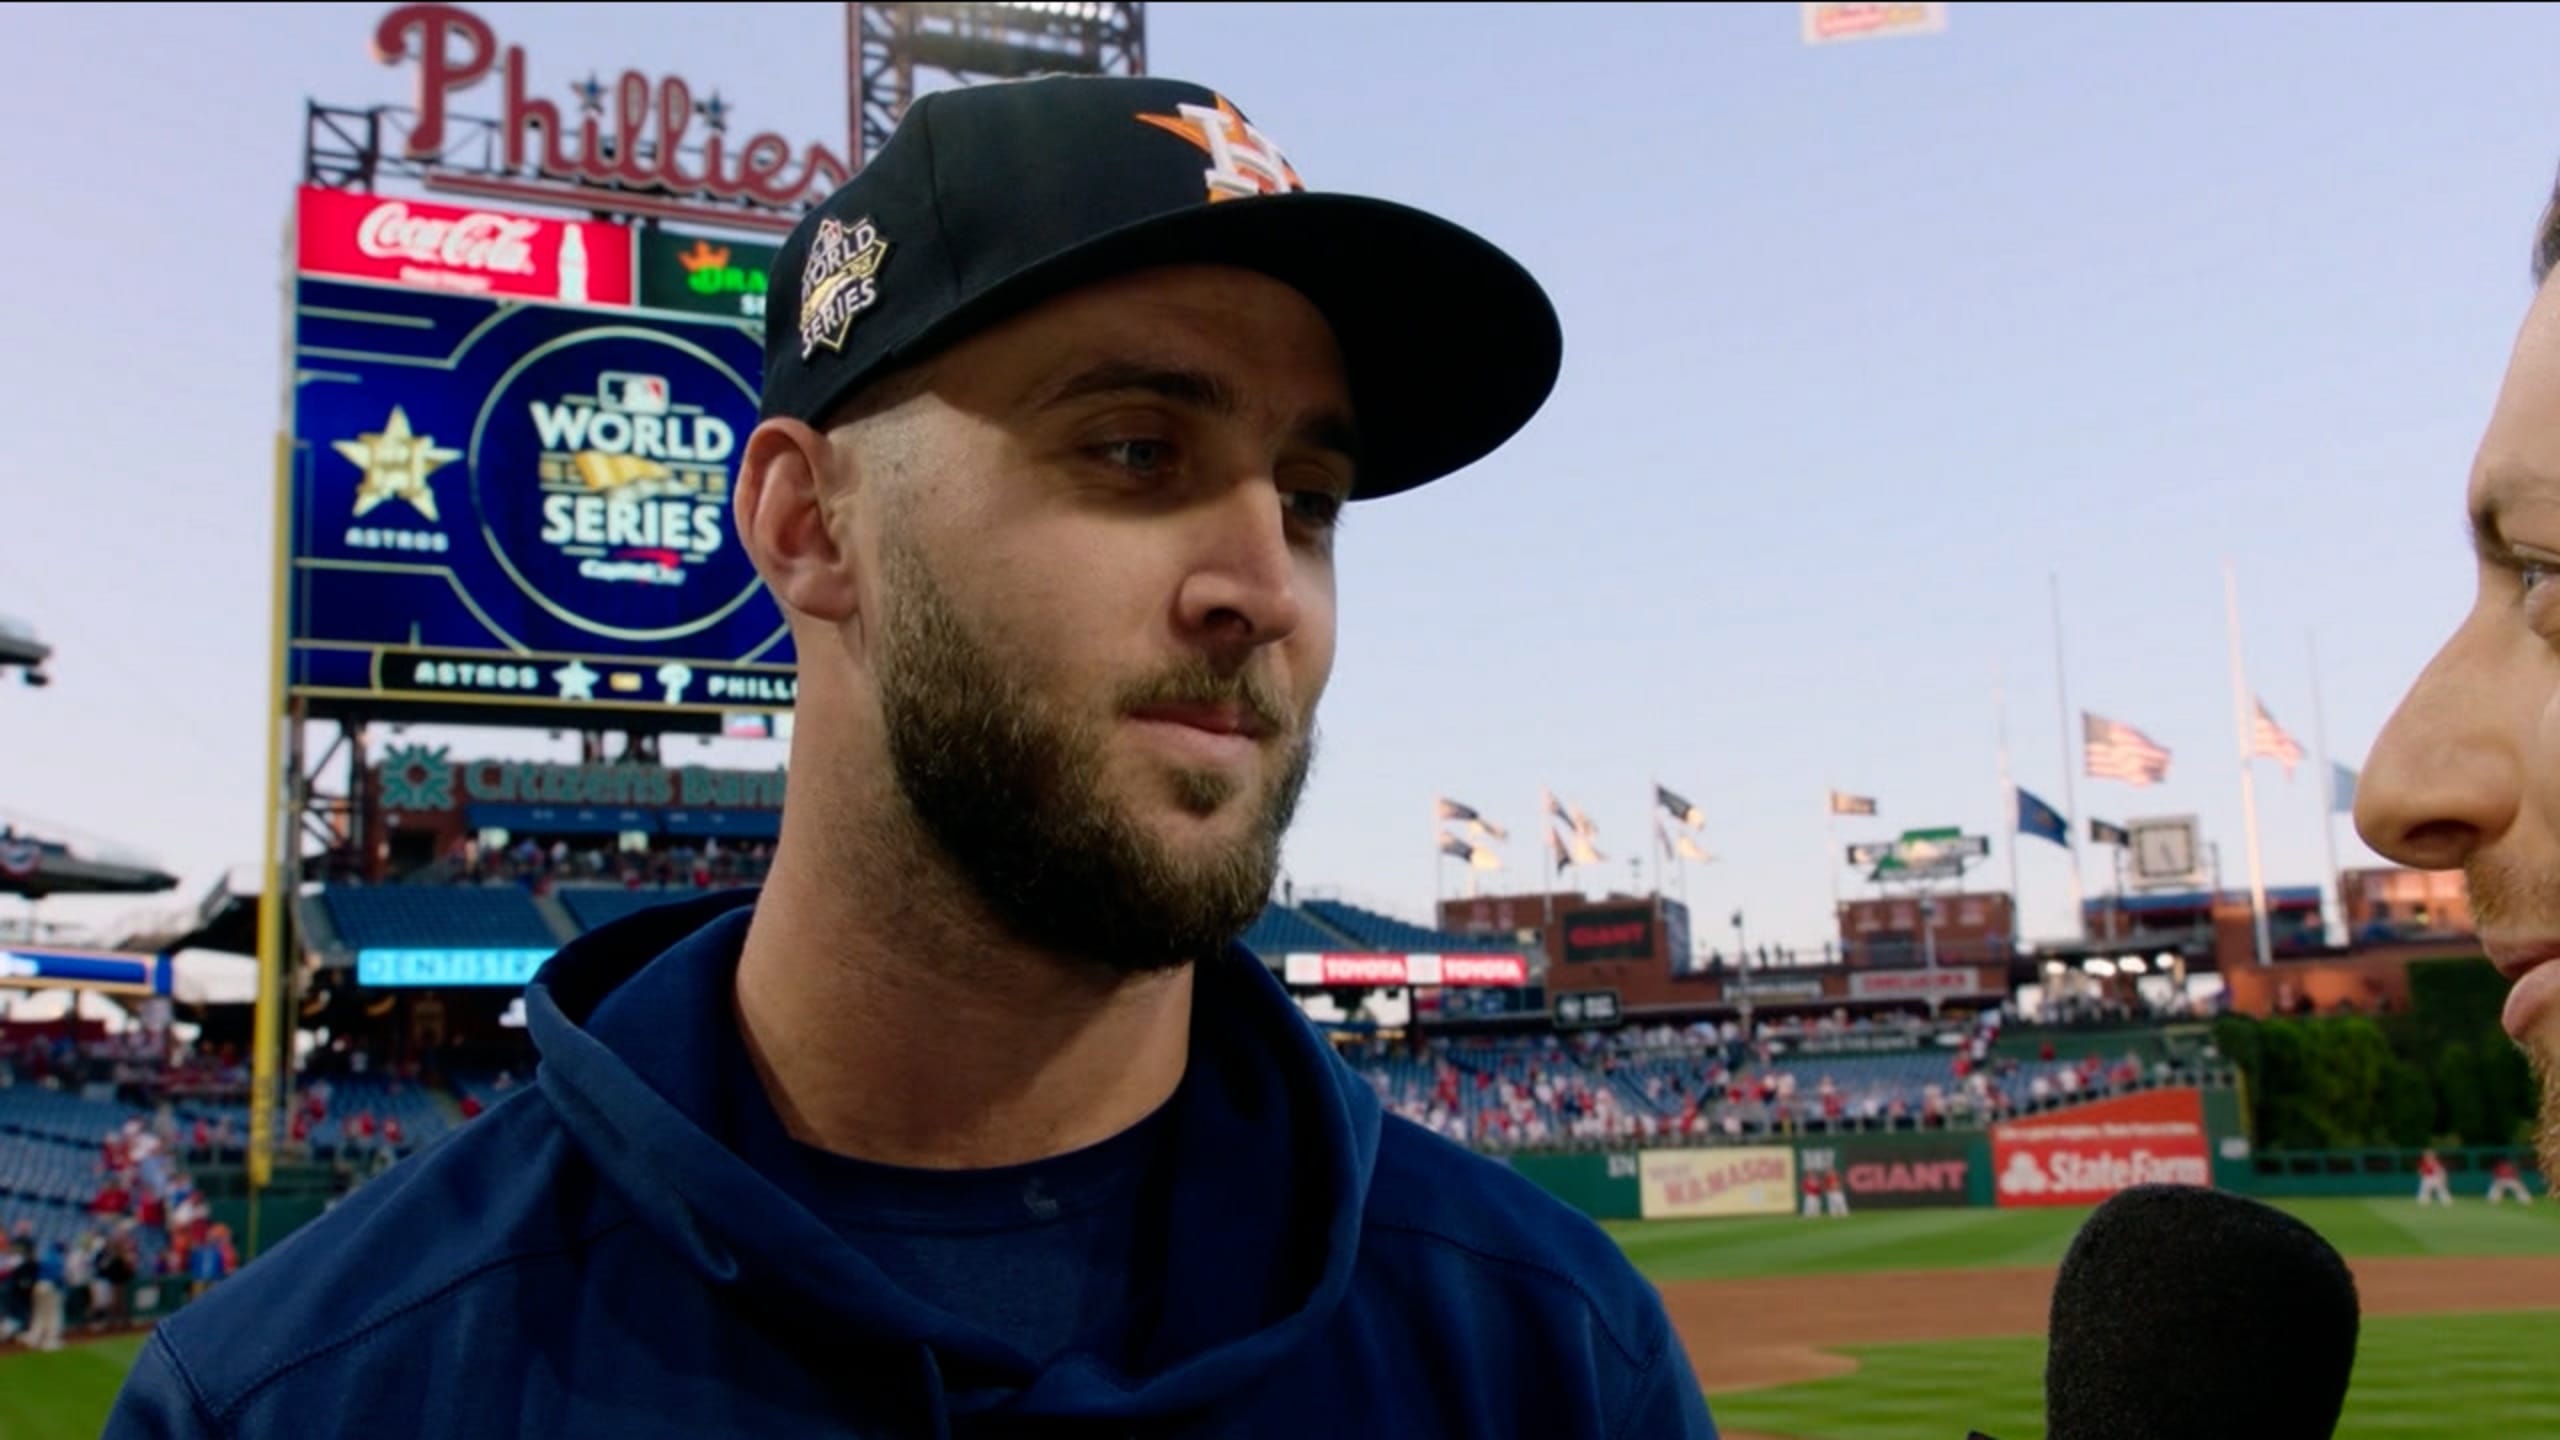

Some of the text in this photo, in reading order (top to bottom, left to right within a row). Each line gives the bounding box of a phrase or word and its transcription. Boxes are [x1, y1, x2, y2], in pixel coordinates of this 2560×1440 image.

[373, 3, 849, 204] Phillies
[801, 277, 877, 360] SERIES
[529, 401, 735, 462] WORLD
[540, 494, 723, 553] SERIES
[414, 661, 539, 689] ASTROS
[464, 760, 674, 804] Citizens
[1324, 956, 1406, 982] TOYOTA
[1443, 956, 1522, 982] TOYOTA
[1847, 1160, 1967, 1193] GIANT
